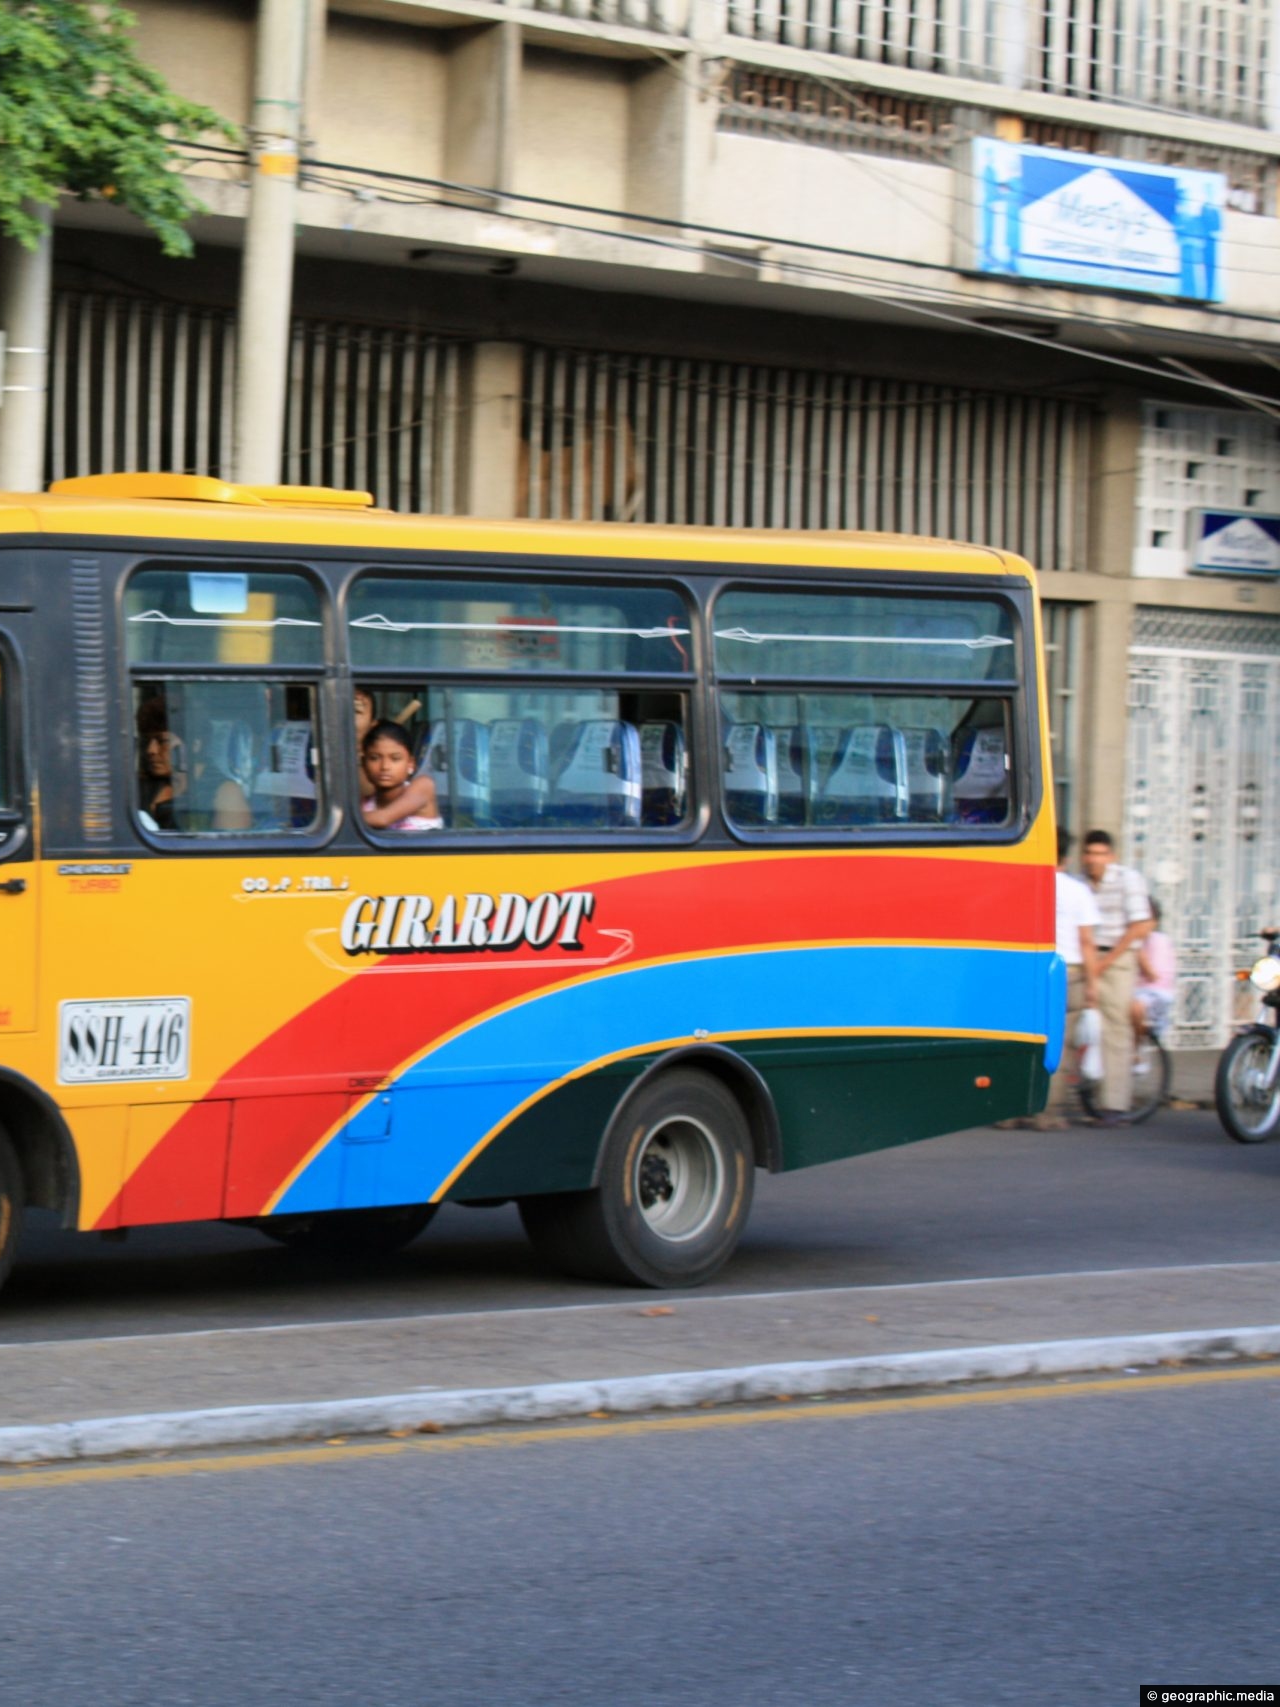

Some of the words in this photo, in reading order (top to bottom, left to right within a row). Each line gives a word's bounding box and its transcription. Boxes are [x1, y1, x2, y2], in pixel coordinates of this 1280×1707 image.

[58, 864, 132, 876] CHEVROLET
[68, 878, 121, 890] TURBO
[340, 891, 595, 954] GIRARDOT
[96, 1066, 162, 1077] GIRARDOT
